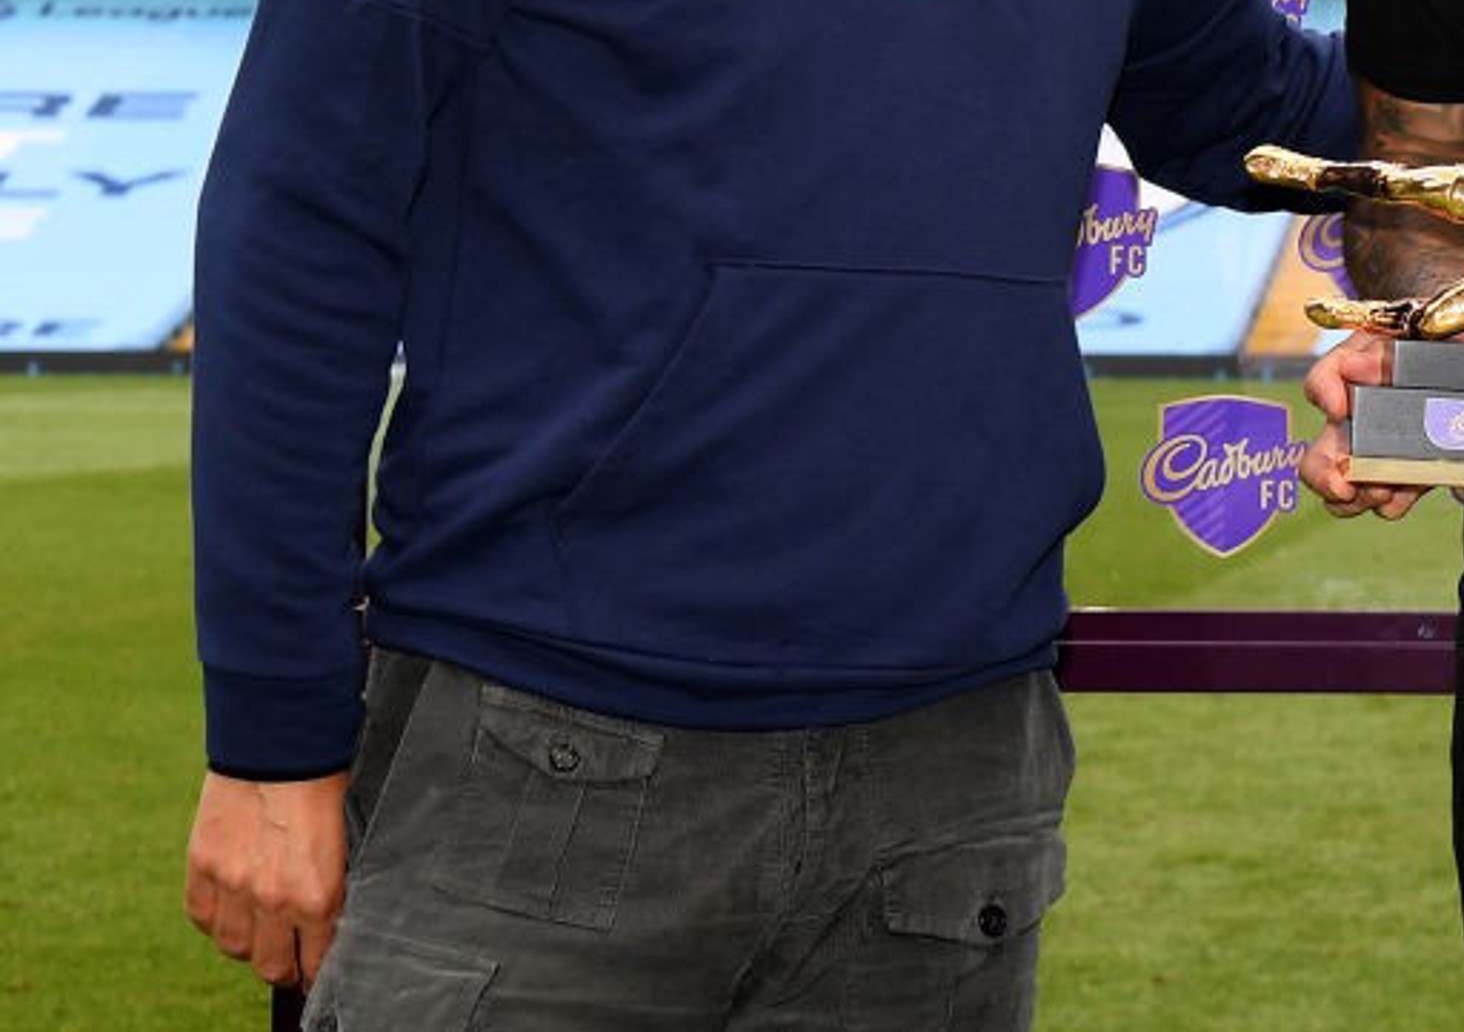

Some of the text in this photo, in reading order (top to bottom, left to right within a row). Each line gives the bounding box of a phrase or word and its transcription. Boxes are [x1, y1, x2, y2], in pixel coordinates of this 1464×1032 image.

[1078, 203, 1156, 248] bury
[1110, 248, 1144, 279] FC
[1144, 434, 1305, 501] Cadbury
[1260, 479, 1294, 510] FC
